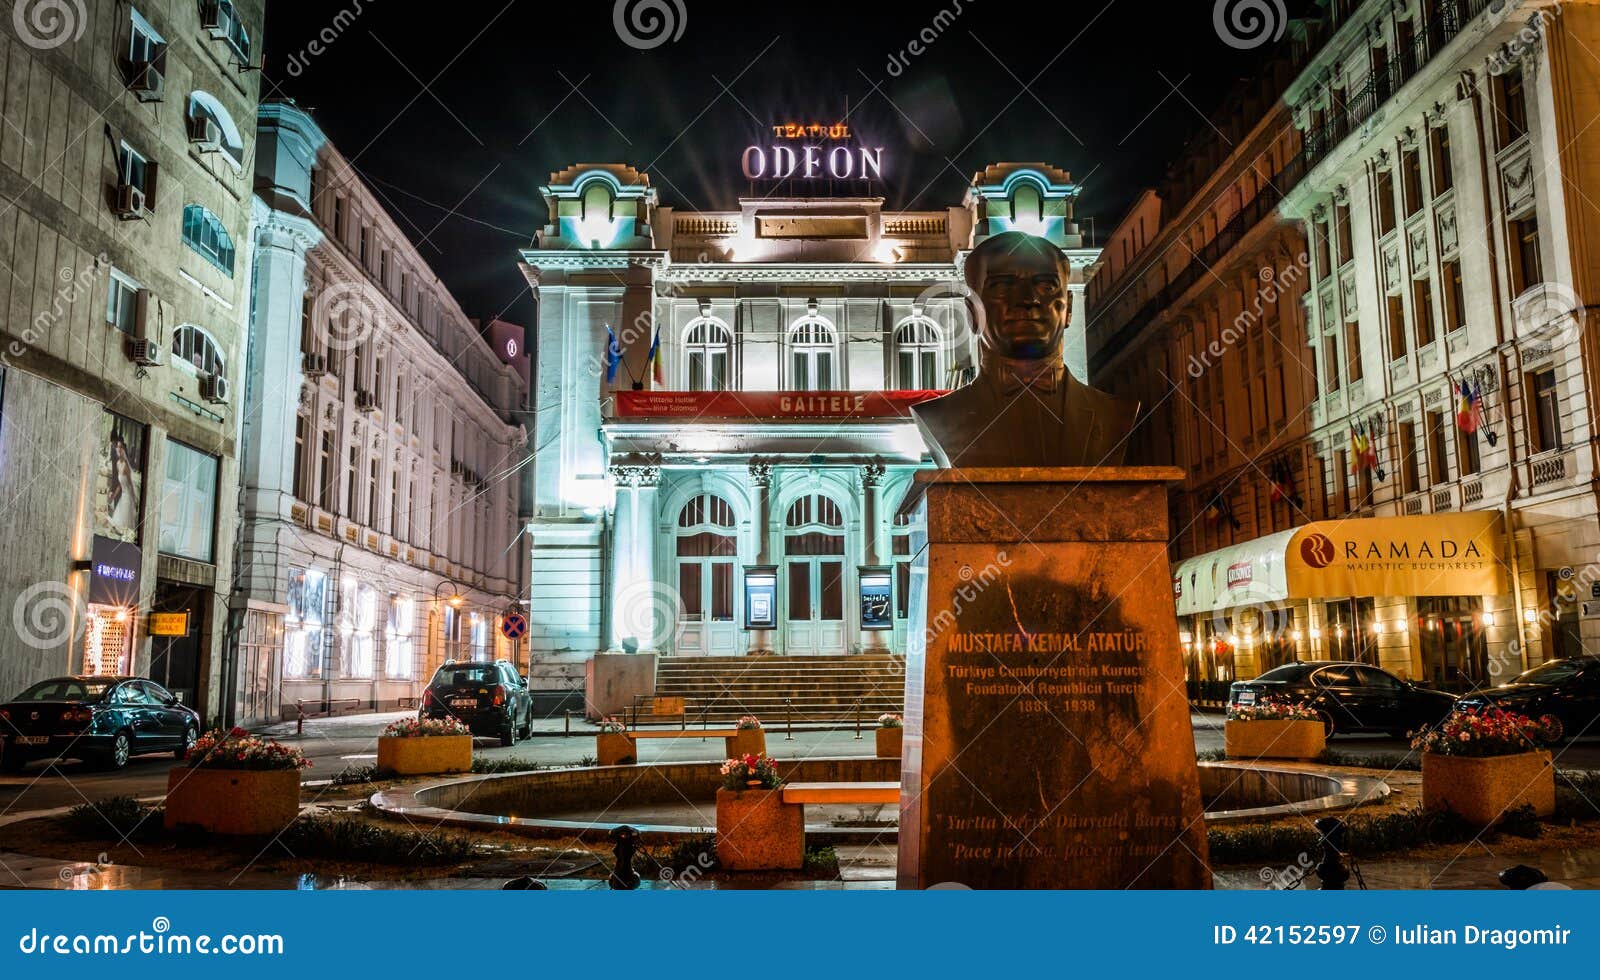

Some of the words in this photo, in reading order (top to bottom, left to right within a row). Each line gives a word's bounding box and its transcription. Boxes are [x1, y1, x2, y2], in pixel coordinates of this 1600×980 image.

[773, 125, 852, 138] TEATRUL
[741, 146, 884, 179] ODEON
[1345, 540, 1481, 559] RAMADA
[1347, 562, 1404, 571] MAJESTIC
[1412, 561, 1484, 570] BUCHAREST
[948, 633, 1023, 652] MUSTAFA
[1026, 633, 1082, 652] KEMAL
[948, 665, 995, 679] Türkiye
[1018, 700, 1048, 712] 1881
[1064, 700, 1096, 712] 1938
